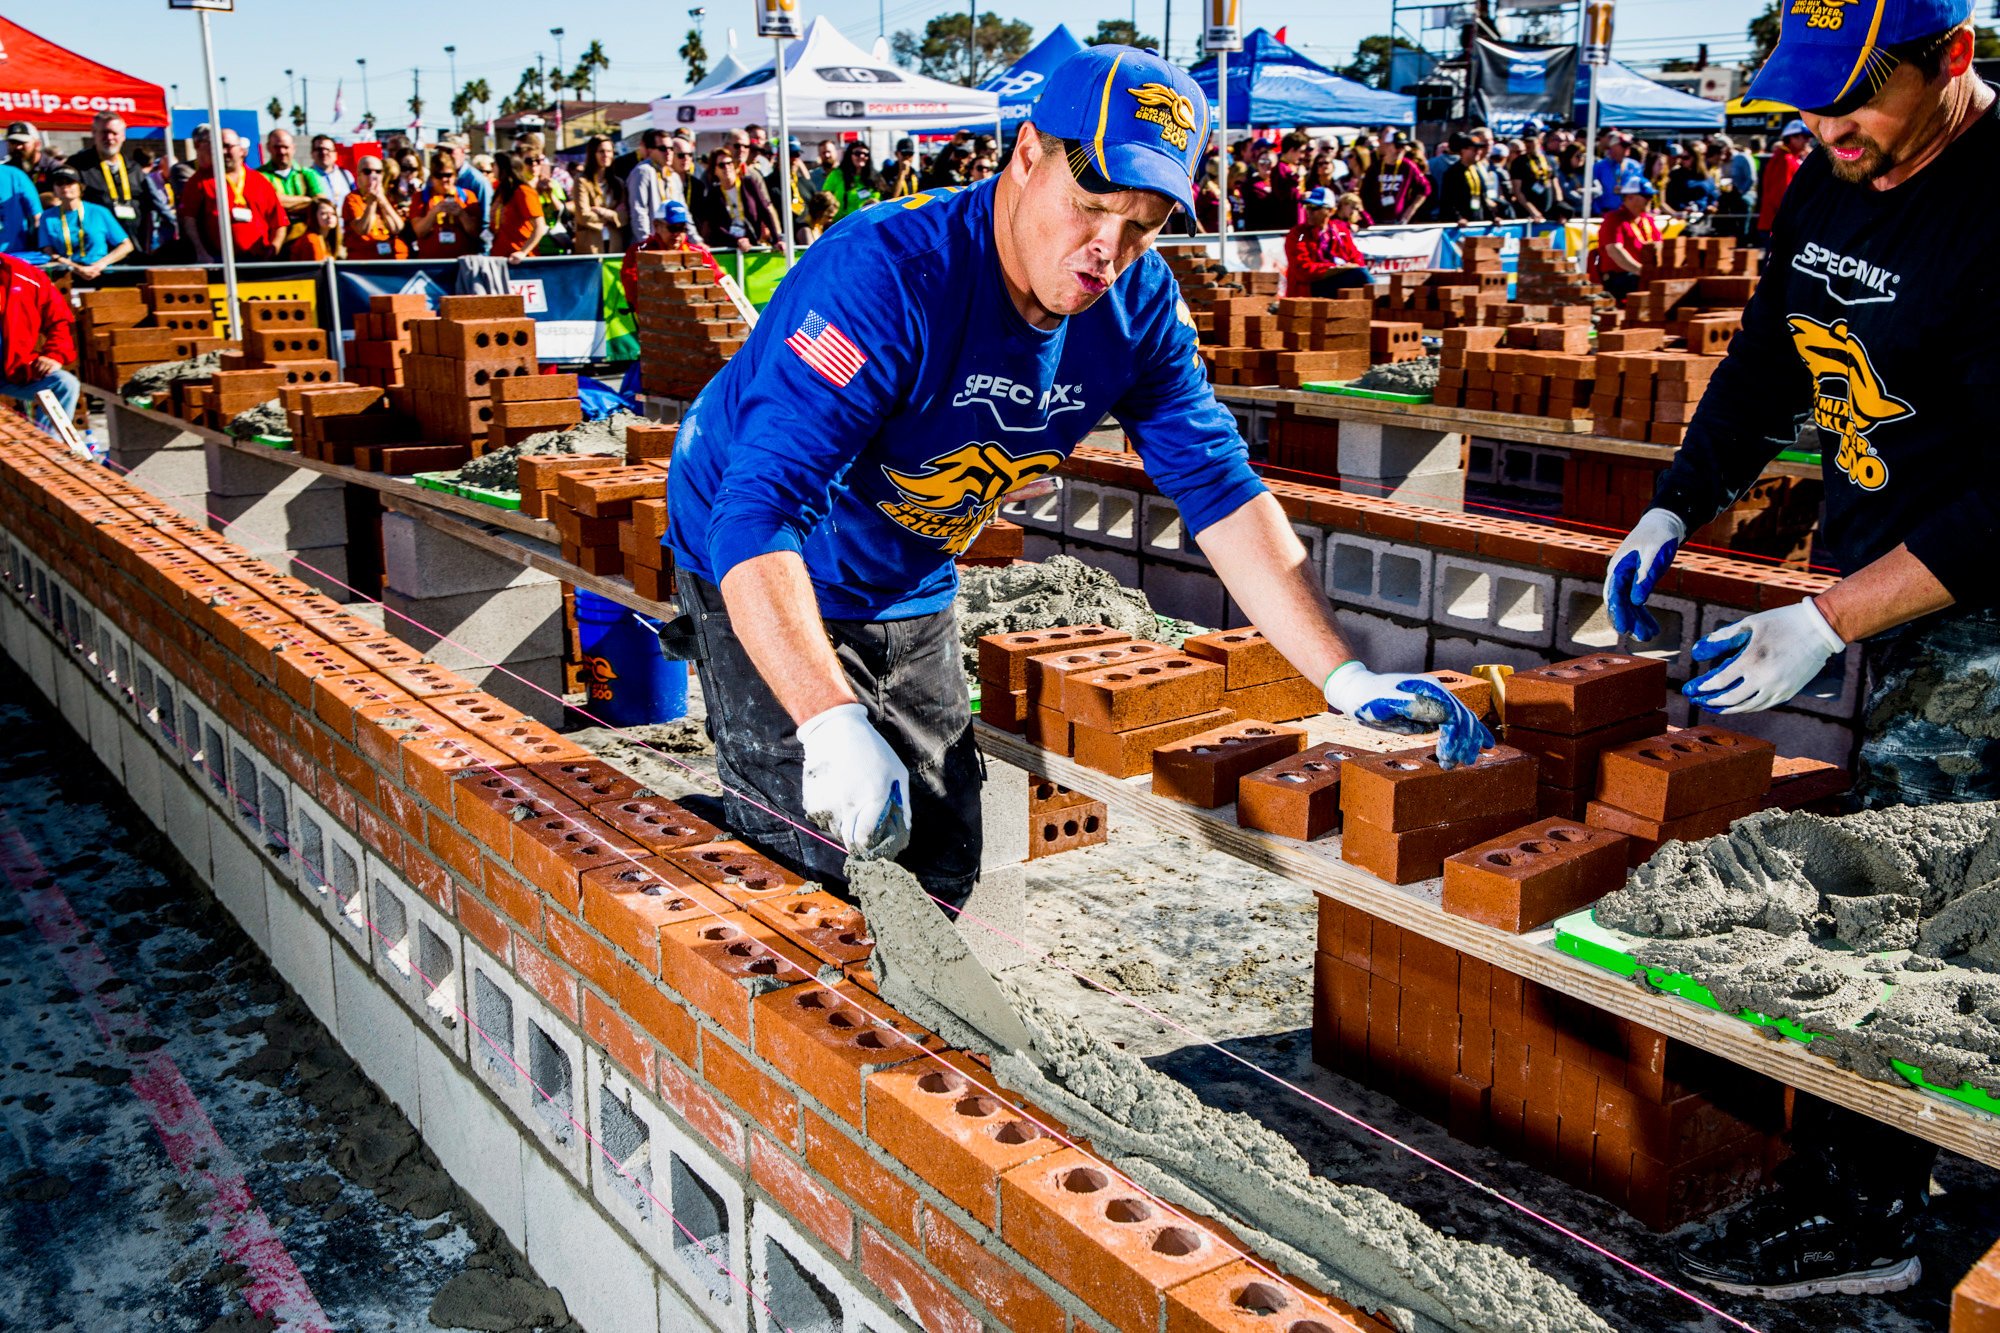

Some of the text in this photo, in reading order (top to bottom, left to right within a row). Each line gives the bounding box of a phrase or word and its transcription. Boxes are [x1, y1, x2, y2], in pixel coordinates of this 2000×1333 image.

[1807, 15, 1842, 30] 500
[868, 103, 910, 114] POWER
[912, 103, 949, 114] TOOLS
[1160, 127, 1188, 151] 500
[964, 374, 1034, 405] SPEC
[1818, 396, 1850, 417] MIX
[899, 503, 946, 523] SPEC
[592, 689, 613, 700] 500
[1803, 1250, 1835, 1263] FILA
